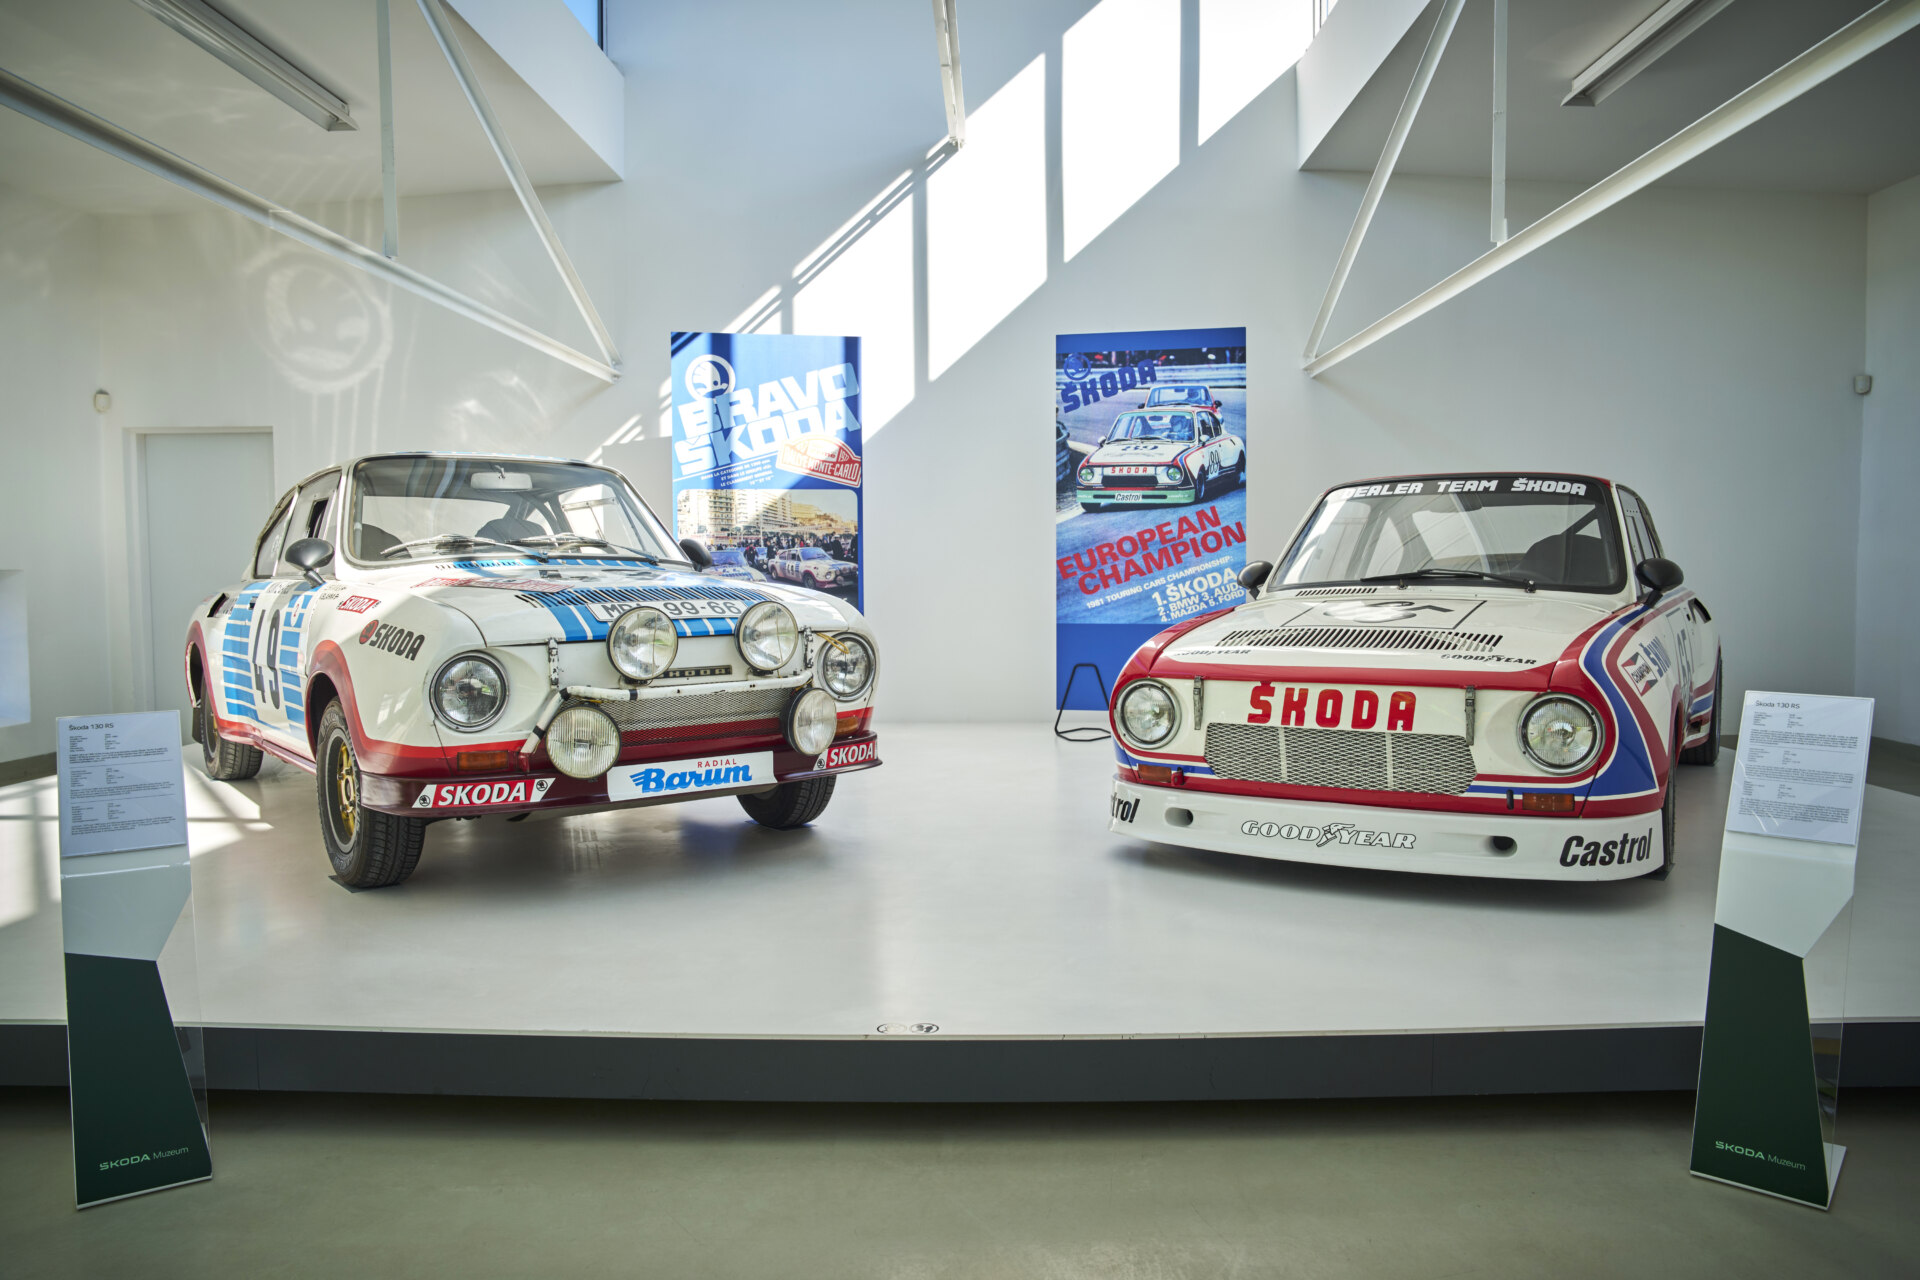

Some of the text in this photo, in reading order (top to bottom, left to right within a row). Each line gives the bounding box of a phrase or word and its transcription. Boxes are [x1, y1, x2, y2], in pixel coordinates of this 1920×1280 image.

[678, 362, 859, 439] BRAVO
[1061, 359, 1157, 413] ŠKODA
[1342, 477, 1587, 499] DEALER TEAM ŠKODA
[1056, 505, 1222, 580] EUROPEAN
[1078, 521, 1246, 595] CHAMPION
[663, 601, 742, 615] 99-66
[1086, 597, 1104, 609] 1981
[1105, 585, 1143, 603] TOURING
[1144, 577, 1167, 591] CARS
[1247, 681, 1417, 732] ŠKODA
[697, 758, 737, 768] RADIAL
[828, 742, 873, 767] SKODA
[438, 782, 527, 806] SKODA
[640, 764, 752, 794] Barum
[1559, 827, 1653, 867] Castrol
[153, 1147, 189, 1160] Muzeum
[1767, 1154, 1806, 1171] Muzeum
